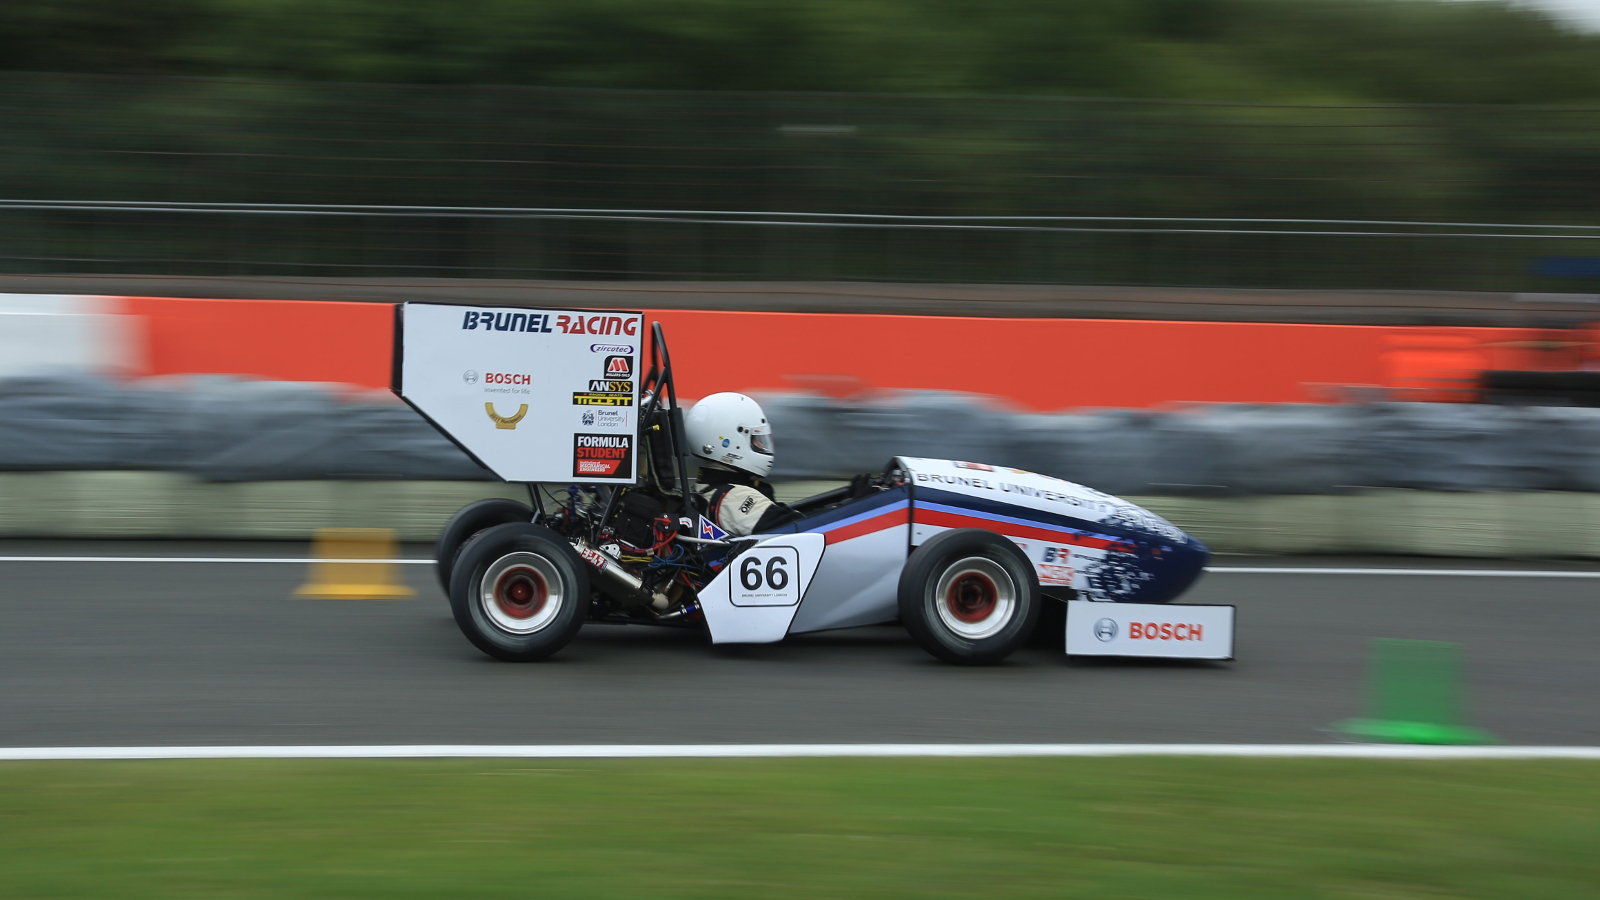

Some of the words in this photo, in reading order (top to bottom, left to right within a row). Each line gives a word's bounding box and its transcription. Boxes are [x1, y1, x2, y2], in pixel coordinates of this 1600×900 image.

[462, 311, 553, 333] BRUNEL
[556, 315, 638, 336] RACING
[485, 372, 531, 385] BOSCH
[590, 380, 631, 392] ANSYS
[577, 436, 629, 448] FORMULA
[576, 447, 627, 459] STUDENT
[917, 473, 996, 490] BRUNEL
[741, 497, 754, 514] OMP
[740, 556, 789, 591] 66
[1128, 622, 1203, 641] BOSCH
